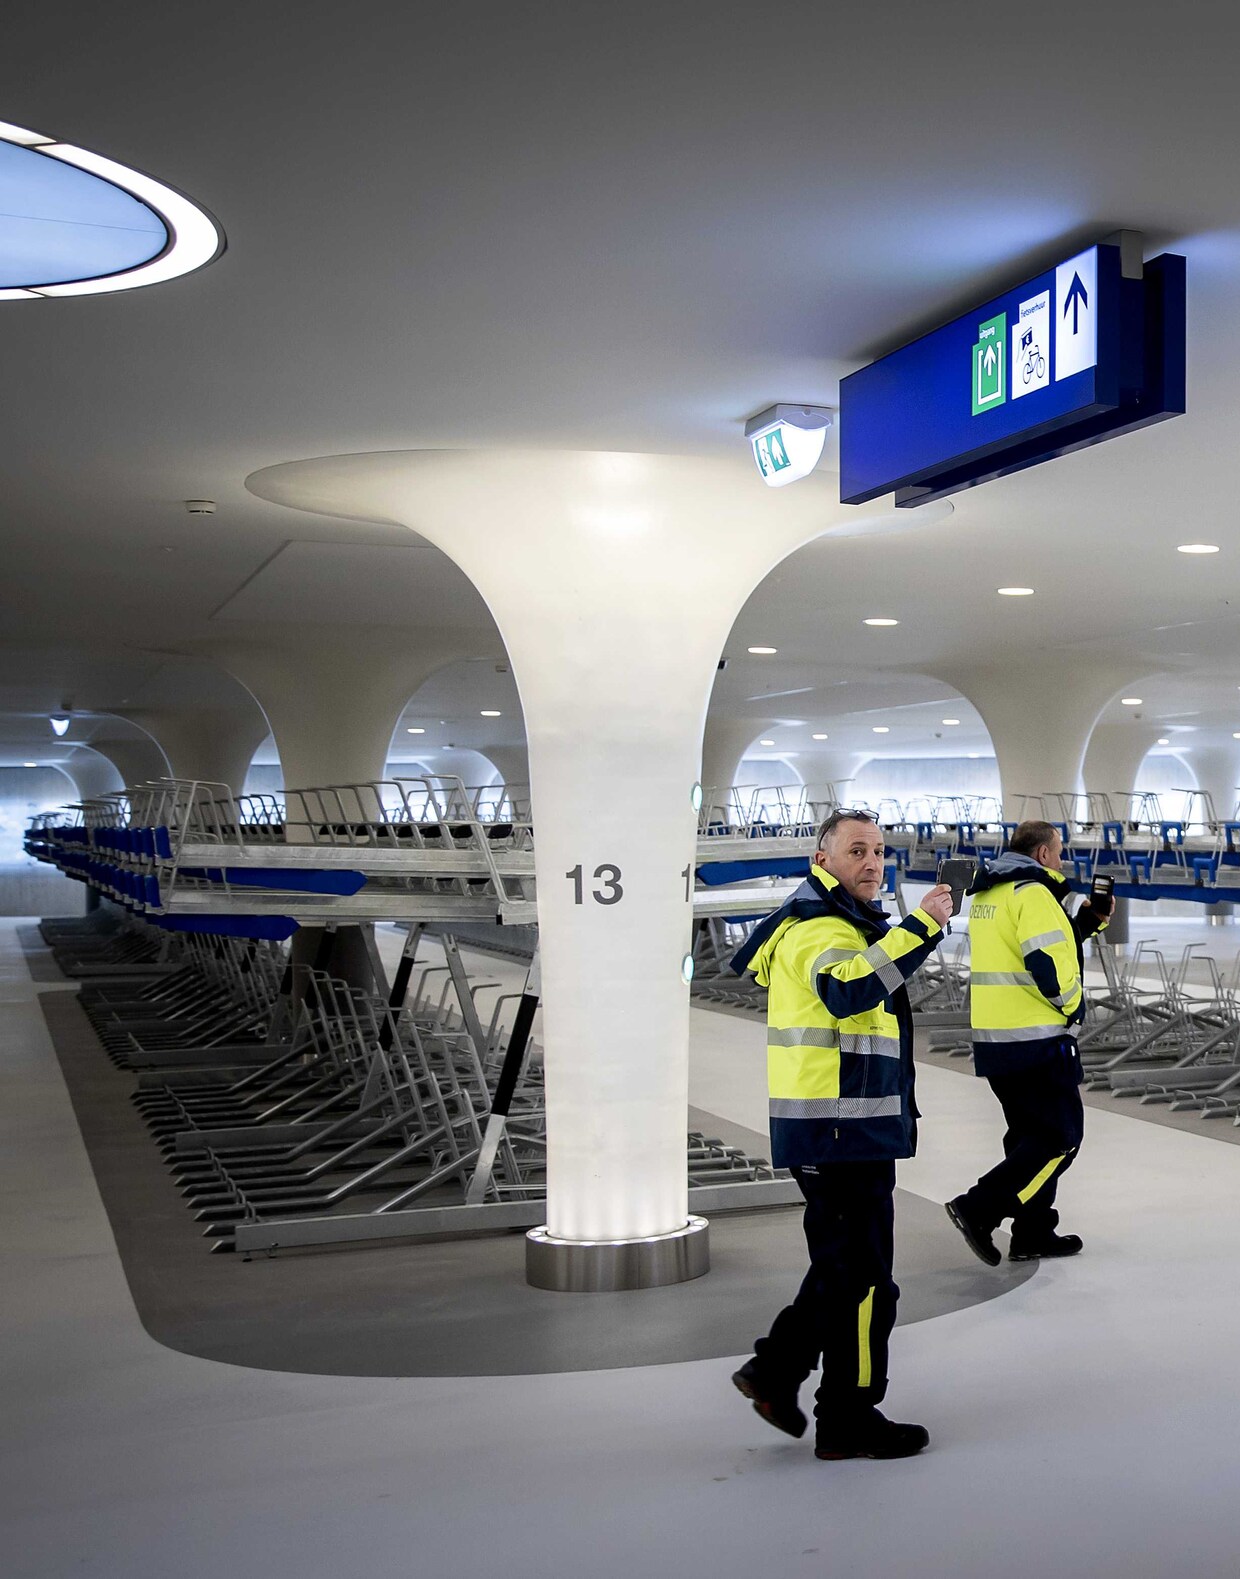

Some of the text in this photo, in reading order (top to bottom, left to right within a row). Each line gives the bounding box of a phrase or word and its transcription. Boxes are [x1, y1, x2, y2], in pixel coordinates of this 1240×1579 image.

[565, 863, 624, 905] 13
[681, 863, 691, 903] 1
[969, 904, 997, 920] OEZICHT
